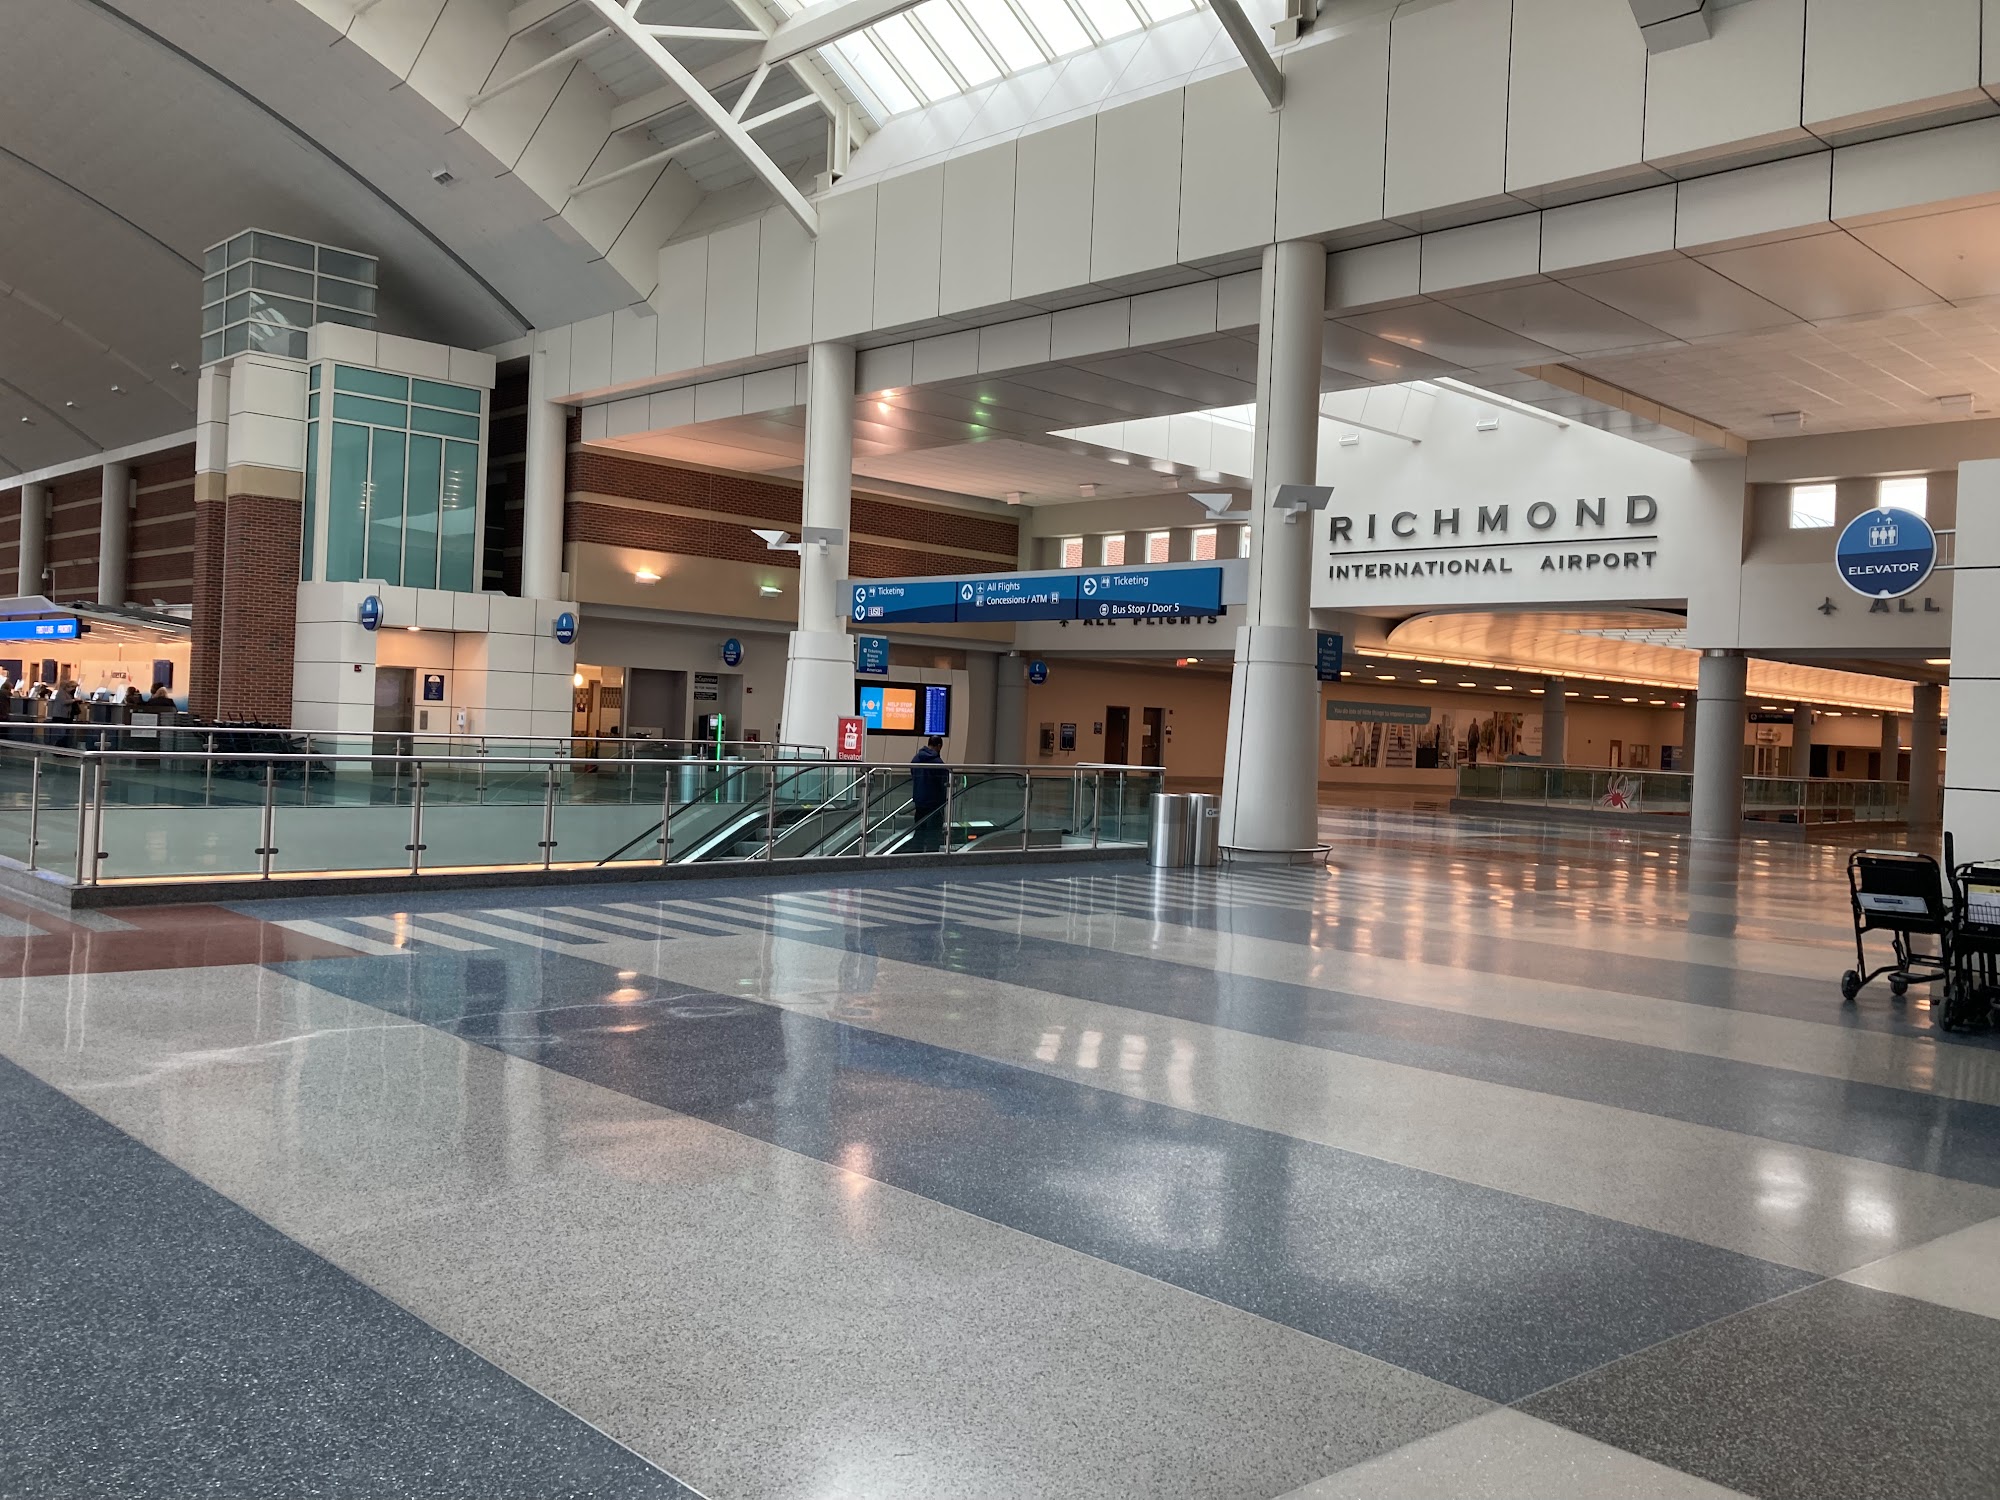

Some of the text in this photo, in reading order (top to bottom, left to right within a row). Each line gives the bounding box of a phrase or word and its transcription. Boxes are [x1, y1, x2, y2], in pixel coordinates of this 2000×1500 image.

[1329, 495, 1658, 541] RICHMOND
[1329, 551, 1657, 579] INTERNATIONAL AIRPORT
[1848, 563, 1919, 575] ELEVATOR
[987, 582, 1020, 593] All Flights
[1113, 576, 1149, 587] Ticketing
[878, 587, 905, 597] Ticketing
[986, 595, 1026, 606] Concessions
[1031, 594, 1047, 604] ATM
[1869, 598, 1940, 612] ALL
[1112, 605, 1126, 614] Bus
[1127, 604, 1145, 615] Stop
[1152, 603, 1173, 613] Door
[1174, 602, 1180, 612] 5
[1133, 615, 1217, 626] FLIGHTS
[838, 752, 862, 761] Elevator
